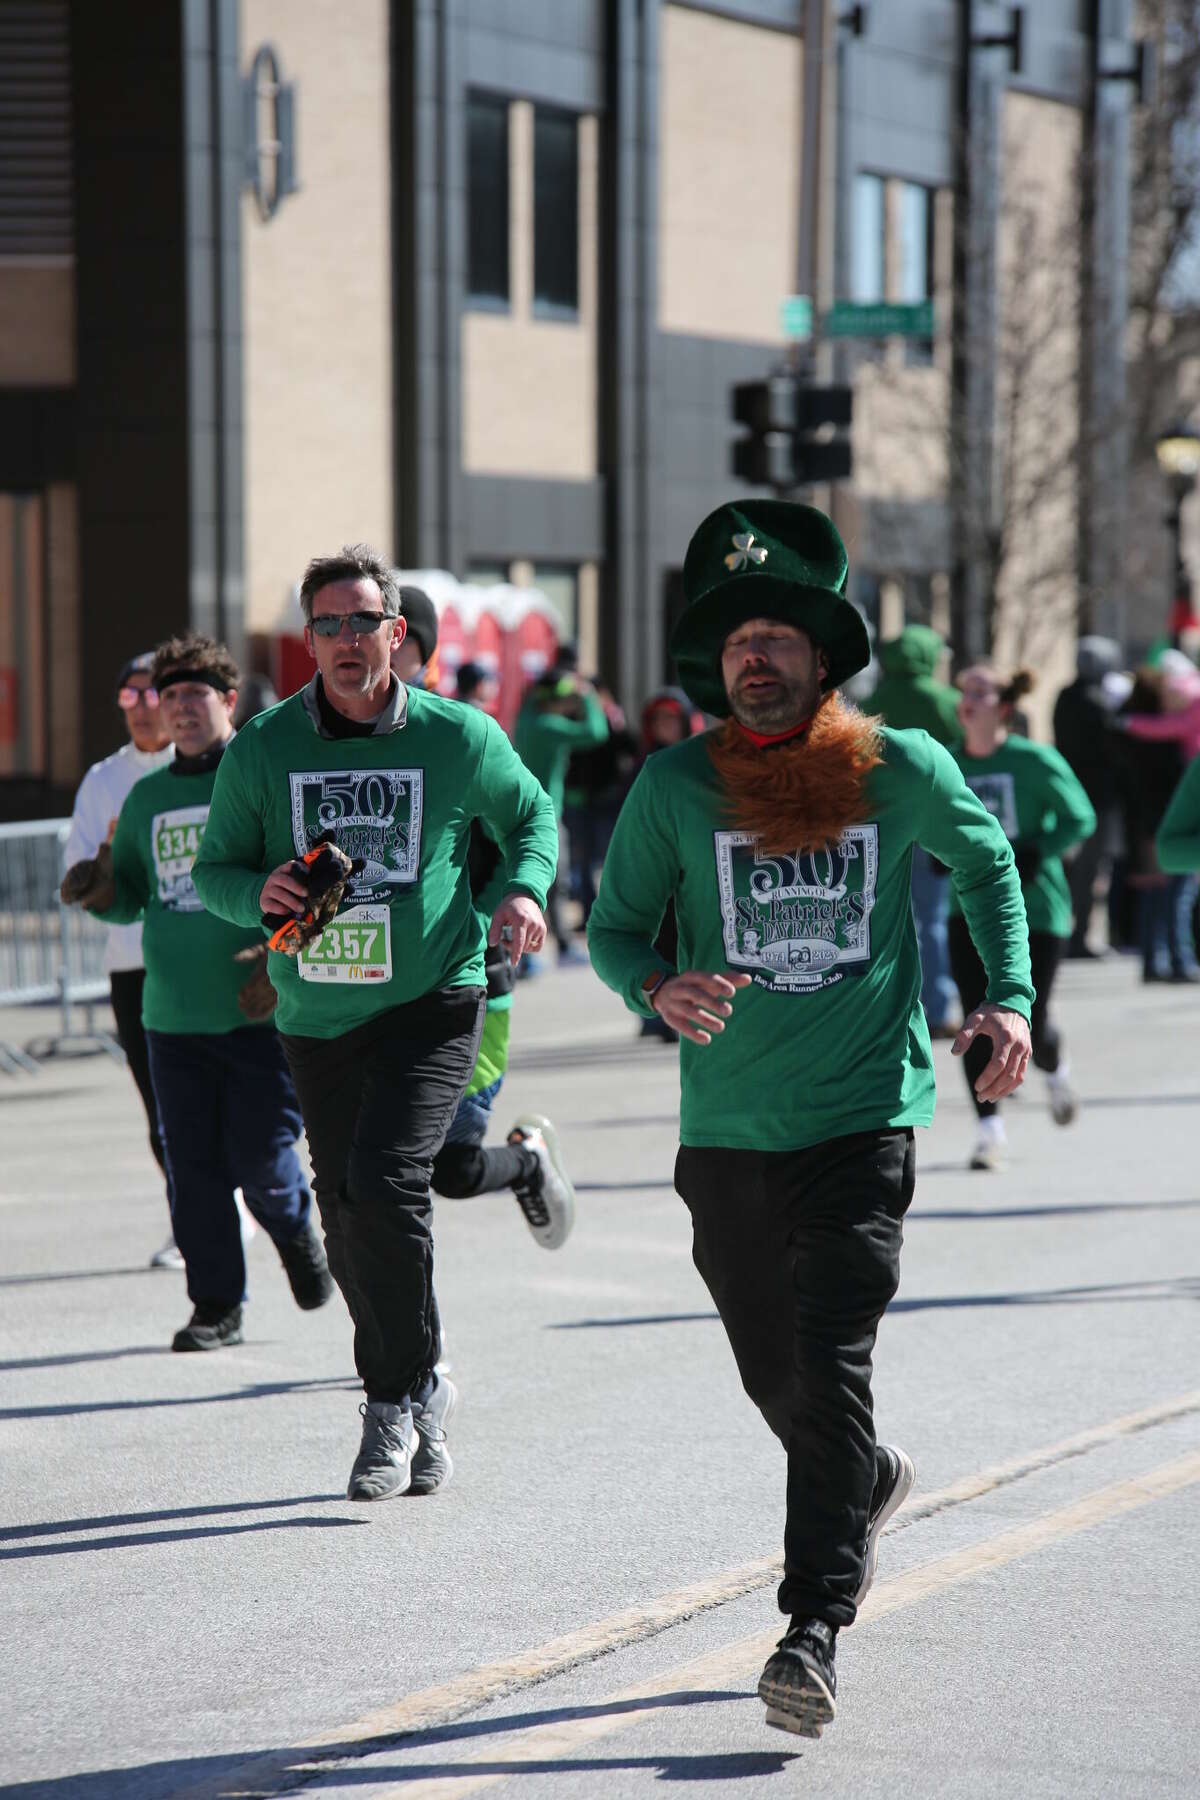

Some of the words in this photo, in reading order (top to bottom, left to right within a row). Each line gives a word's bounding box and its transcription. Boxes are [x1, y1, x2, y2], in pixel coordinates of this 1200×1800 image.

[374, 889, 392, 900] Club
[771, 887, 814, 899] RUNNING
[359, 911, 374, 921] 5K
[735, 896, 765, 929] St.
[763, 920, 790, 944] DAY
[792, 920, 836, 940] RACES
[308, 928, 378, 960] 2357
[754, 974, 768, 988] Bay
[768, 983, 788, 991] Area
[789, 983, 823, 993] Runners
[823, 972, 843, 986] Club
